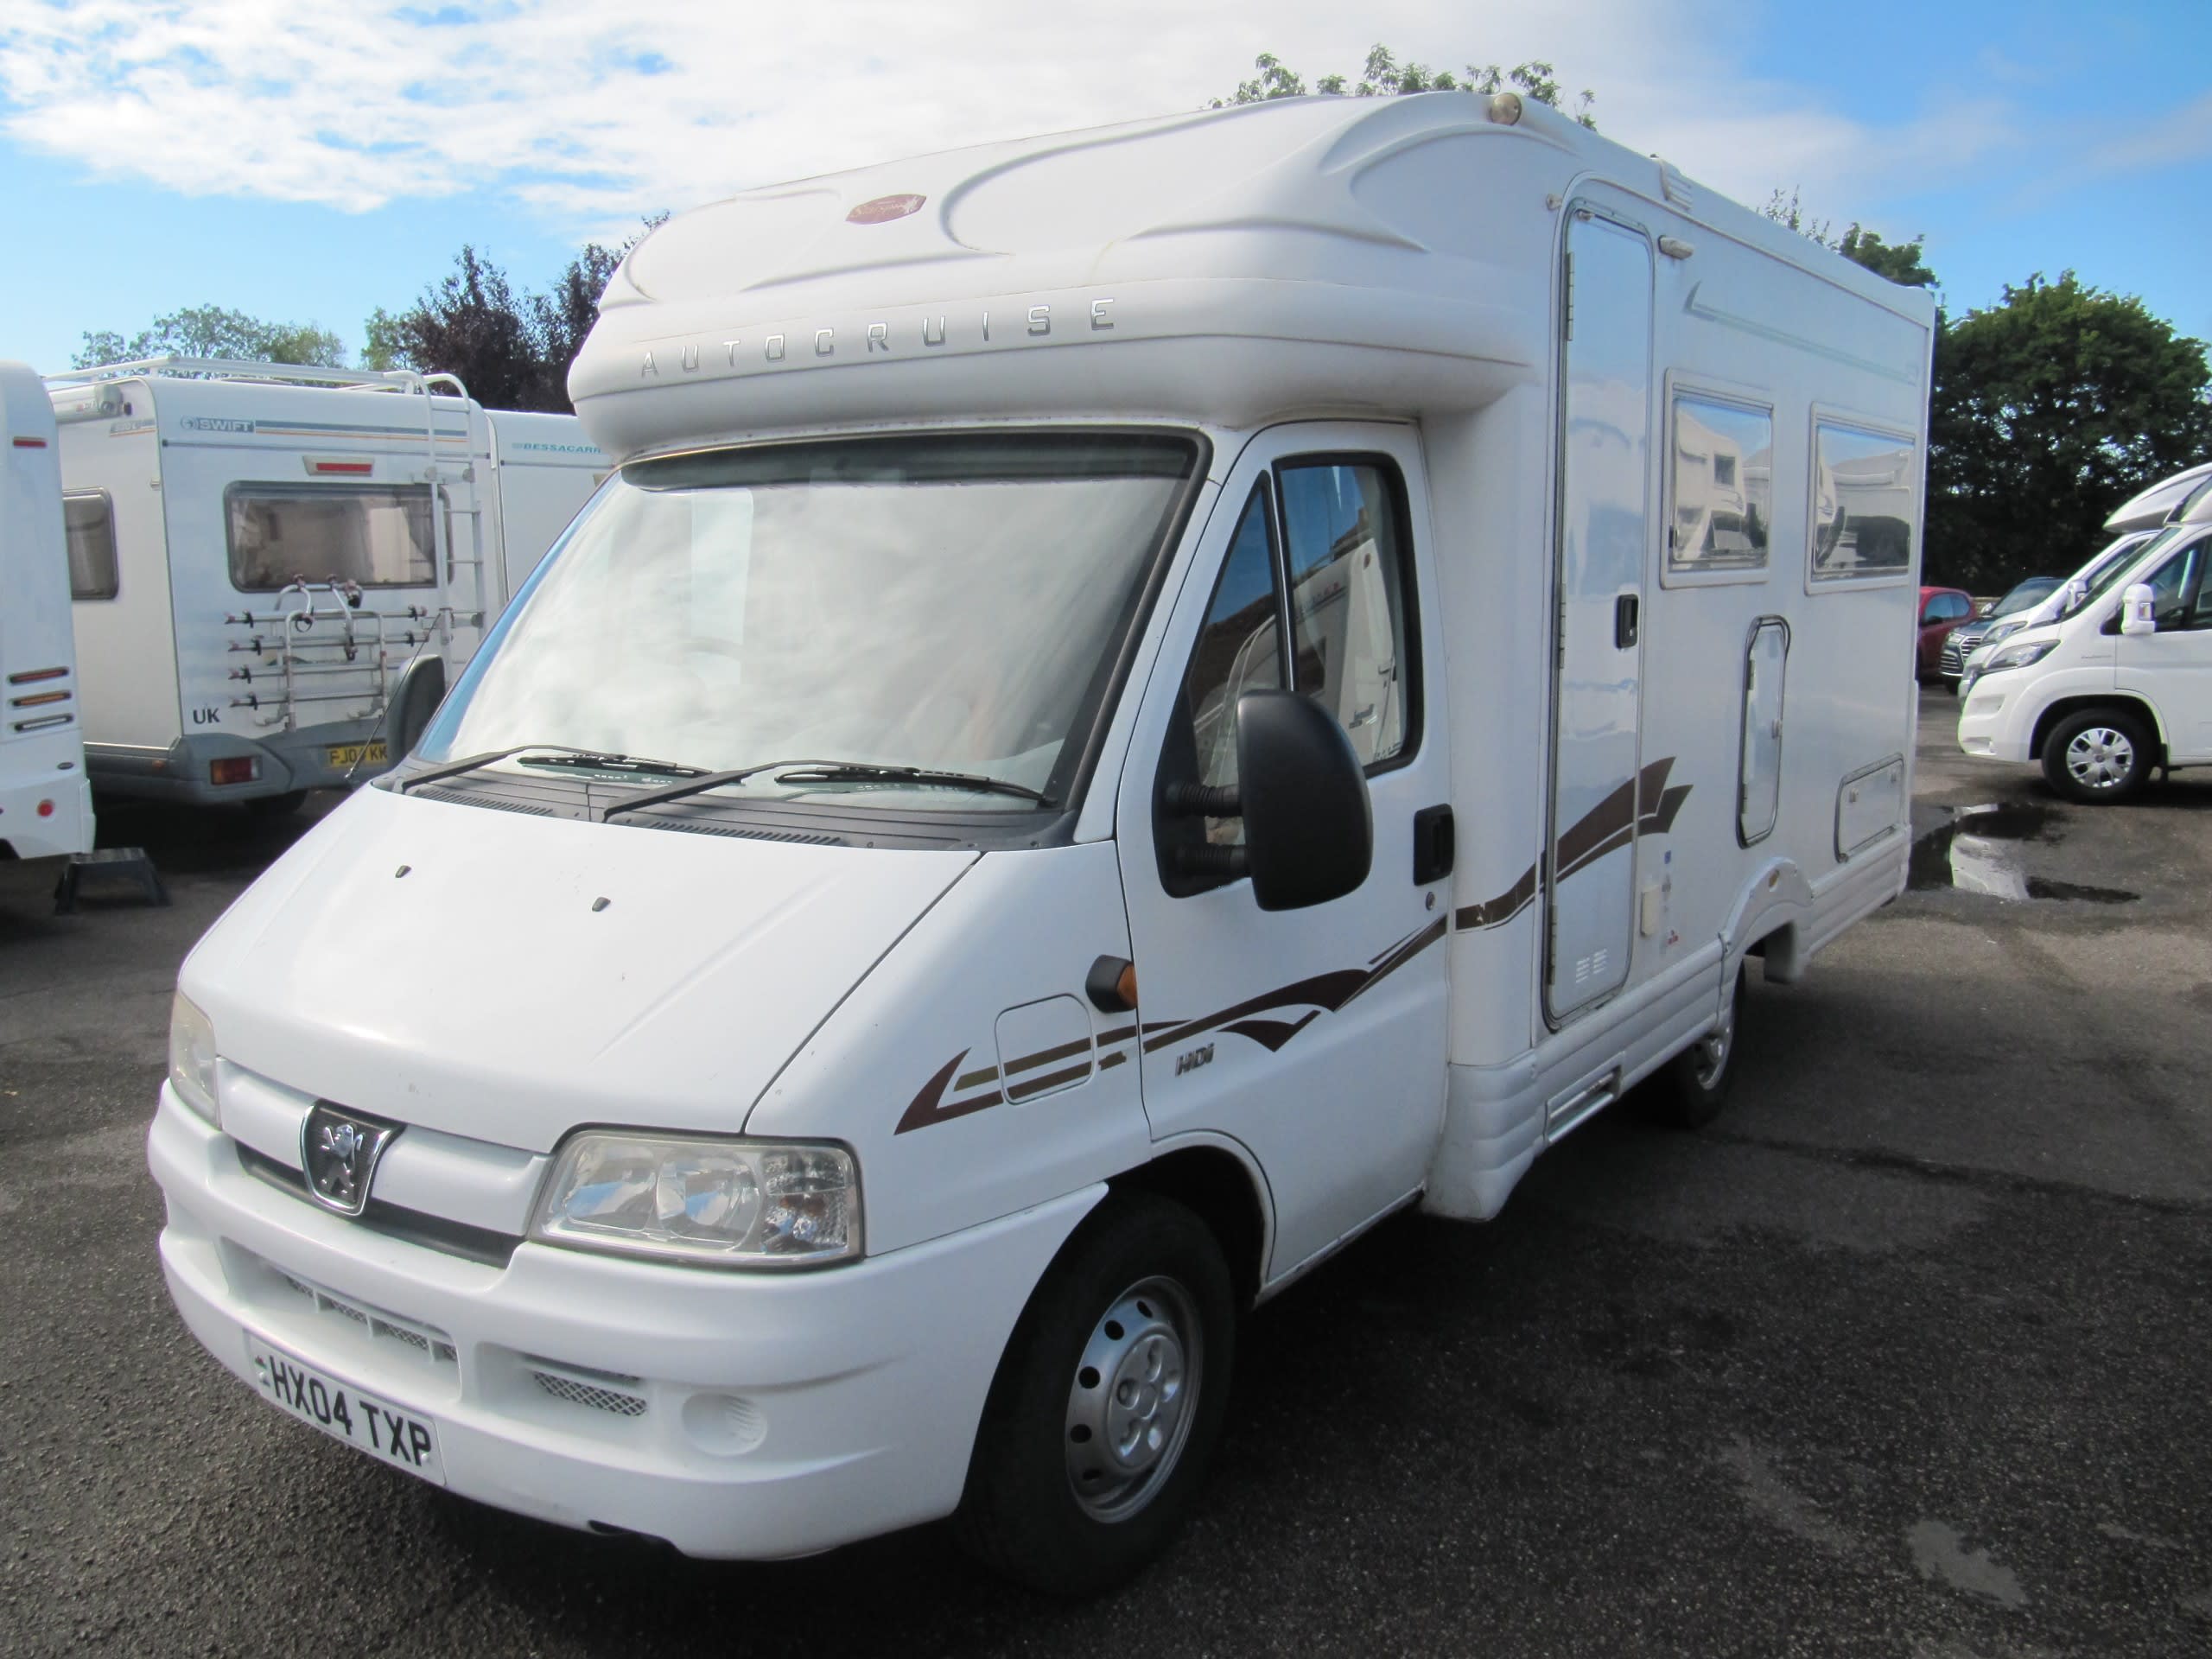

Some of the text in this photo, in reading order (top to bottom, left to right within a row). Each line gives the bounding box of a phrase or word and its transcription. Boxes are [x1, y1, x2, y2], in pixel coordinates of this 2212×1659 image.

[641, 297, 1116, 378] AUTOCRUISE
[199, 418, 251, 432] SWIFT
[524, 442, 601, 454] BESSACARR
[193, 708, 220, 725] UK
[269, 1355, 432, 1467] HX04 TXP
